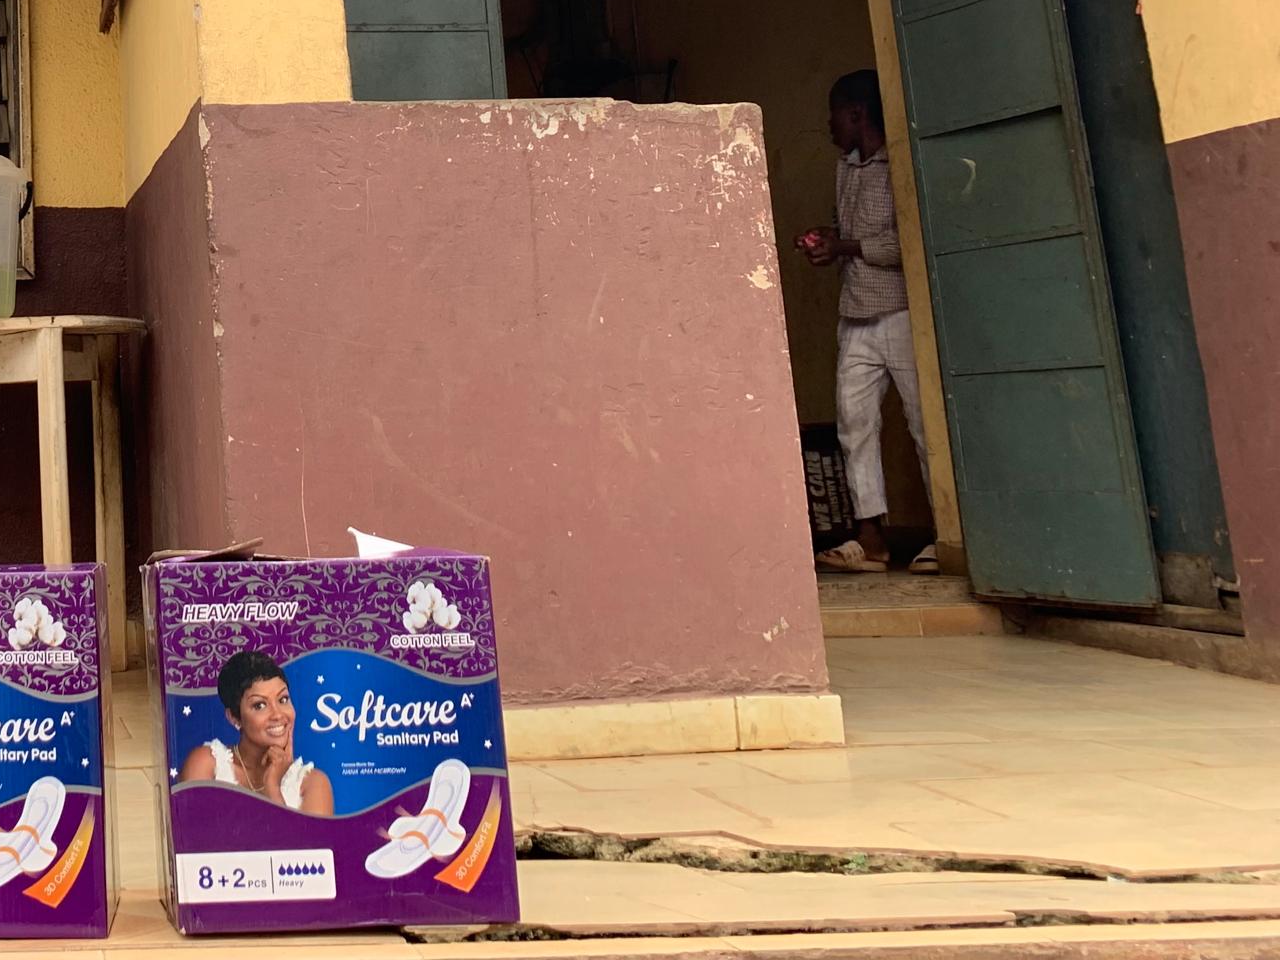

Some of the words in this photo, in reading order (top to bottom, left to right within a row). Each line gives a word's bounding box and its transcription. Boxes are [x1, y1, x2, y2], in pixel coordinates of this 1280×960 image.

[812, 502, 832, 531] WE
[182, 603, 243, 622] HEAVY
[244, 602, 298, 620] FLOW
[390, 634, 441, 648] COTTON
[442, 633, 475, 647] FEEL
[46, 650, 79, 664] FEEL
[310, 690, 456, 741] Softcare
[376, 732, 431, 747] Sanitary
[433, 730, 459, 745] Pad
[31, 747, 57, 761] Pad
[456, 866, 468, 880] 3D
[44, 882, 56, 896] 3D
[279, 880, 304, 888] Heavy
